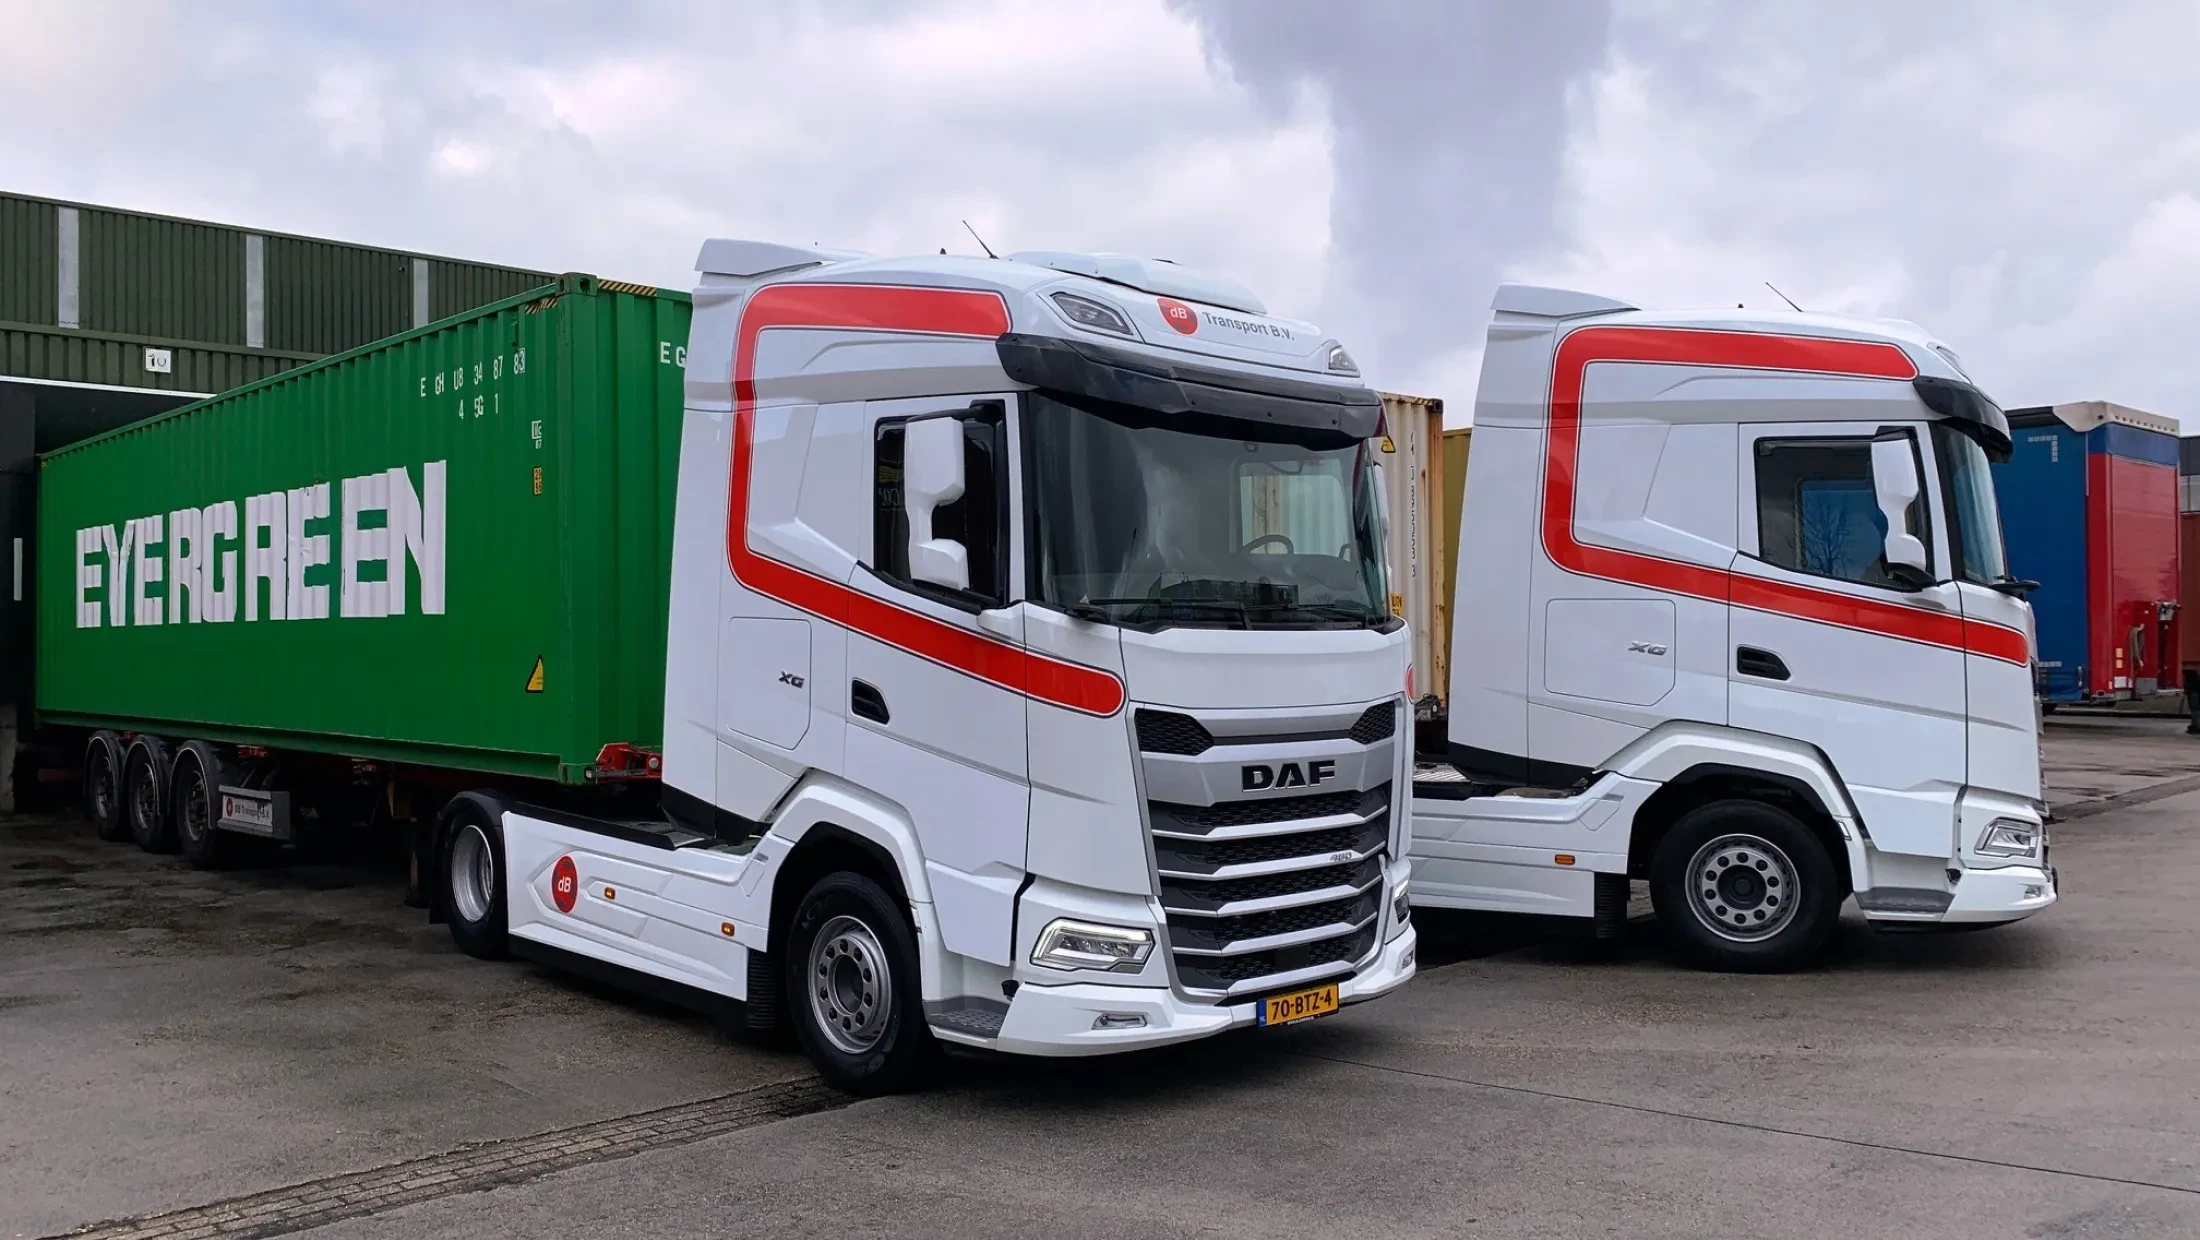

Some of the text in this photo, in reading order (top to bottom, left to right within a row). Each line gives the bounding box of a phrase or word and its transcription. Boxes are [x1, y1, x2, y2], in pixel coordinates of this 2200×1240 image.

[1170, 306, 1295, 341] dB Transport B.V.
[1627, 640, 1668, 657] XG
[778, 670, 805, 689] XG
[1241, 760, 1336, 792] DAF
[557, 875, 572, 893] dB
[1271, 988, 1332, 1020] 70-BTZ-4
